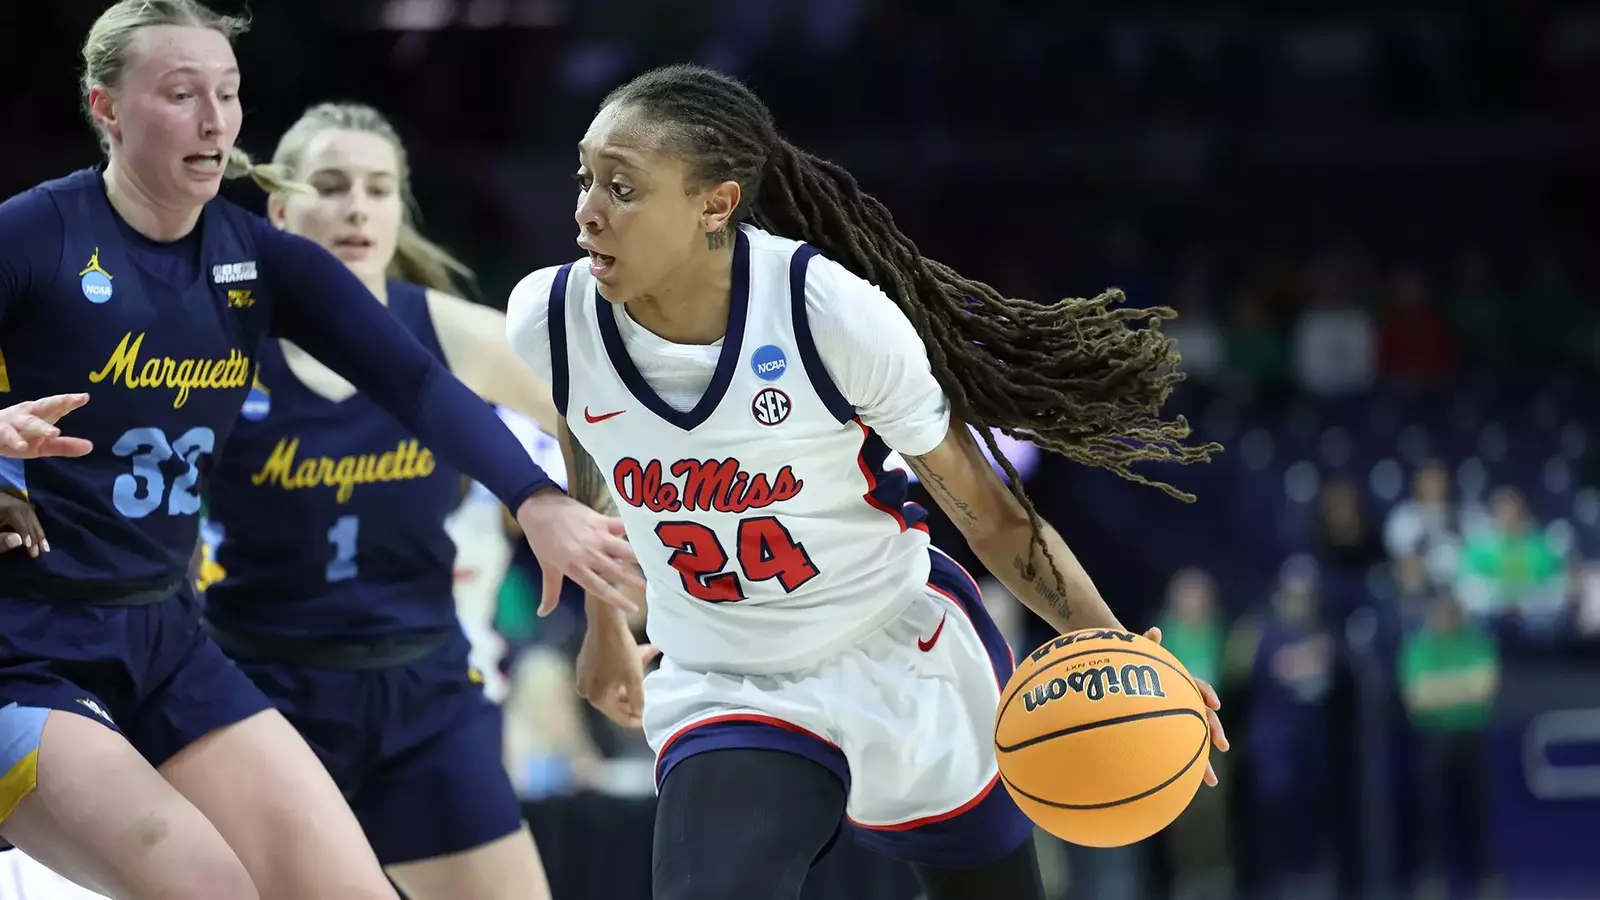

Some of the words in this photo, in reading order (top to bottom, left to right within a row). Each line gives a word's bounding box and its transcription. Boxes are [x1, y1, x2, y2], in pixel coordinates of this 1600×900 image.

[86, 284, 112, 296] NCAA
[214, 270, 257, 283] CHANGE
[757, 359, 786, 373] NCAA
[754, 390, 789, 424] SEC
[112, 426, 215, 519] 32
[251, 436, 436, 504] Marquette
[613, 456, 682, 513] Ole
[669, 456, 803, 514] Miss
[325, 515, 360, 583] 1
[653, 515, 821, 604] 24
[1064, 662, 1086, 672] NXT
[1088, 658, 1112, 667] EVO
[1022, 663, 1167, 713] Wilson
